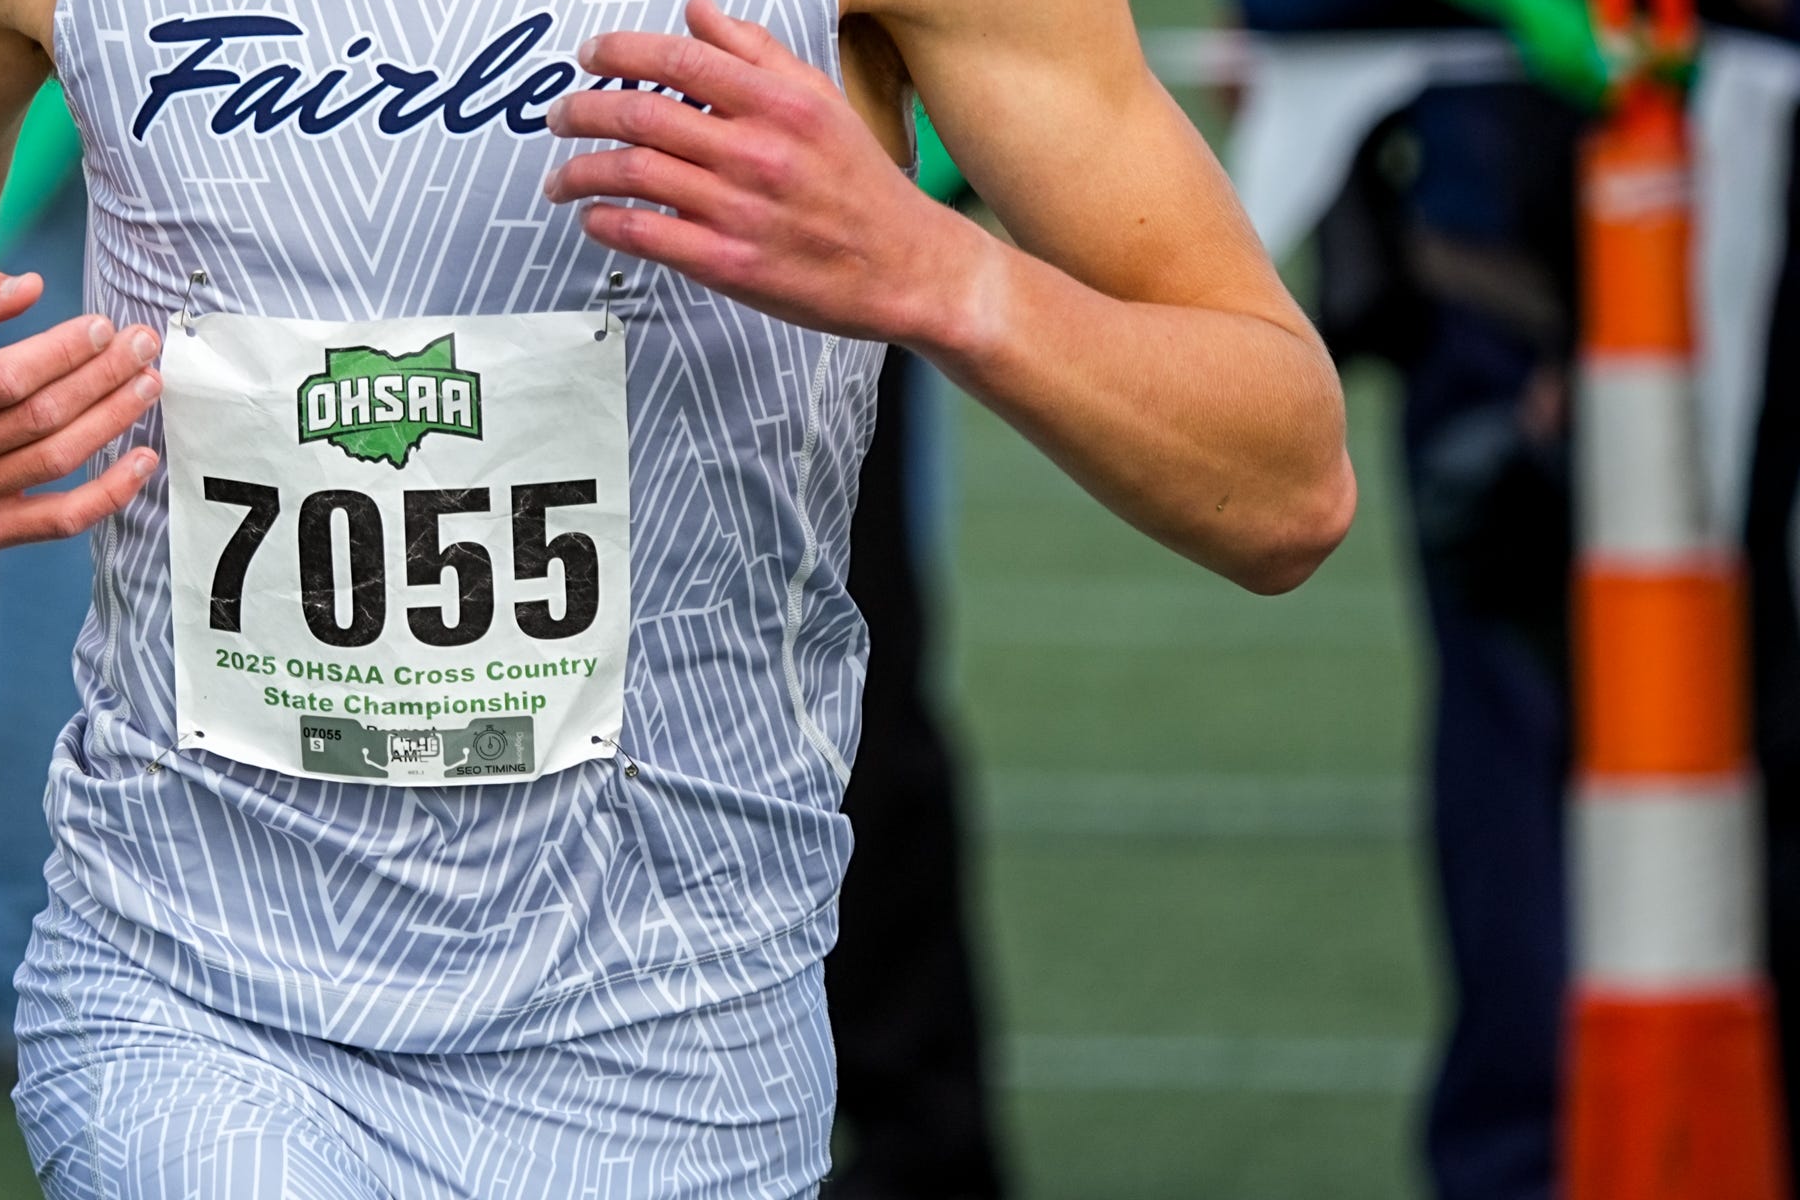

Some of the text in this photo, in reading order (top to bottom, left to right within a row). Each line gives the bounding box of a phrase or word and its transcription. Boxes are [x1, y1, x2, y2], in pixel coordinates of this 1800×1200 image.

[132, 12, 712, 142] Fairle
[307, 375, 472, 431] OHSAA
[203, 476, 600, 648] 7055
[215, 648, 598, 686] 2025 OHSAA Cross Country
[263, 686, 547, 720] State Championship
[303, 726, 342, 741] 07055
[456, 763, 527, 775] SEO TIMING
